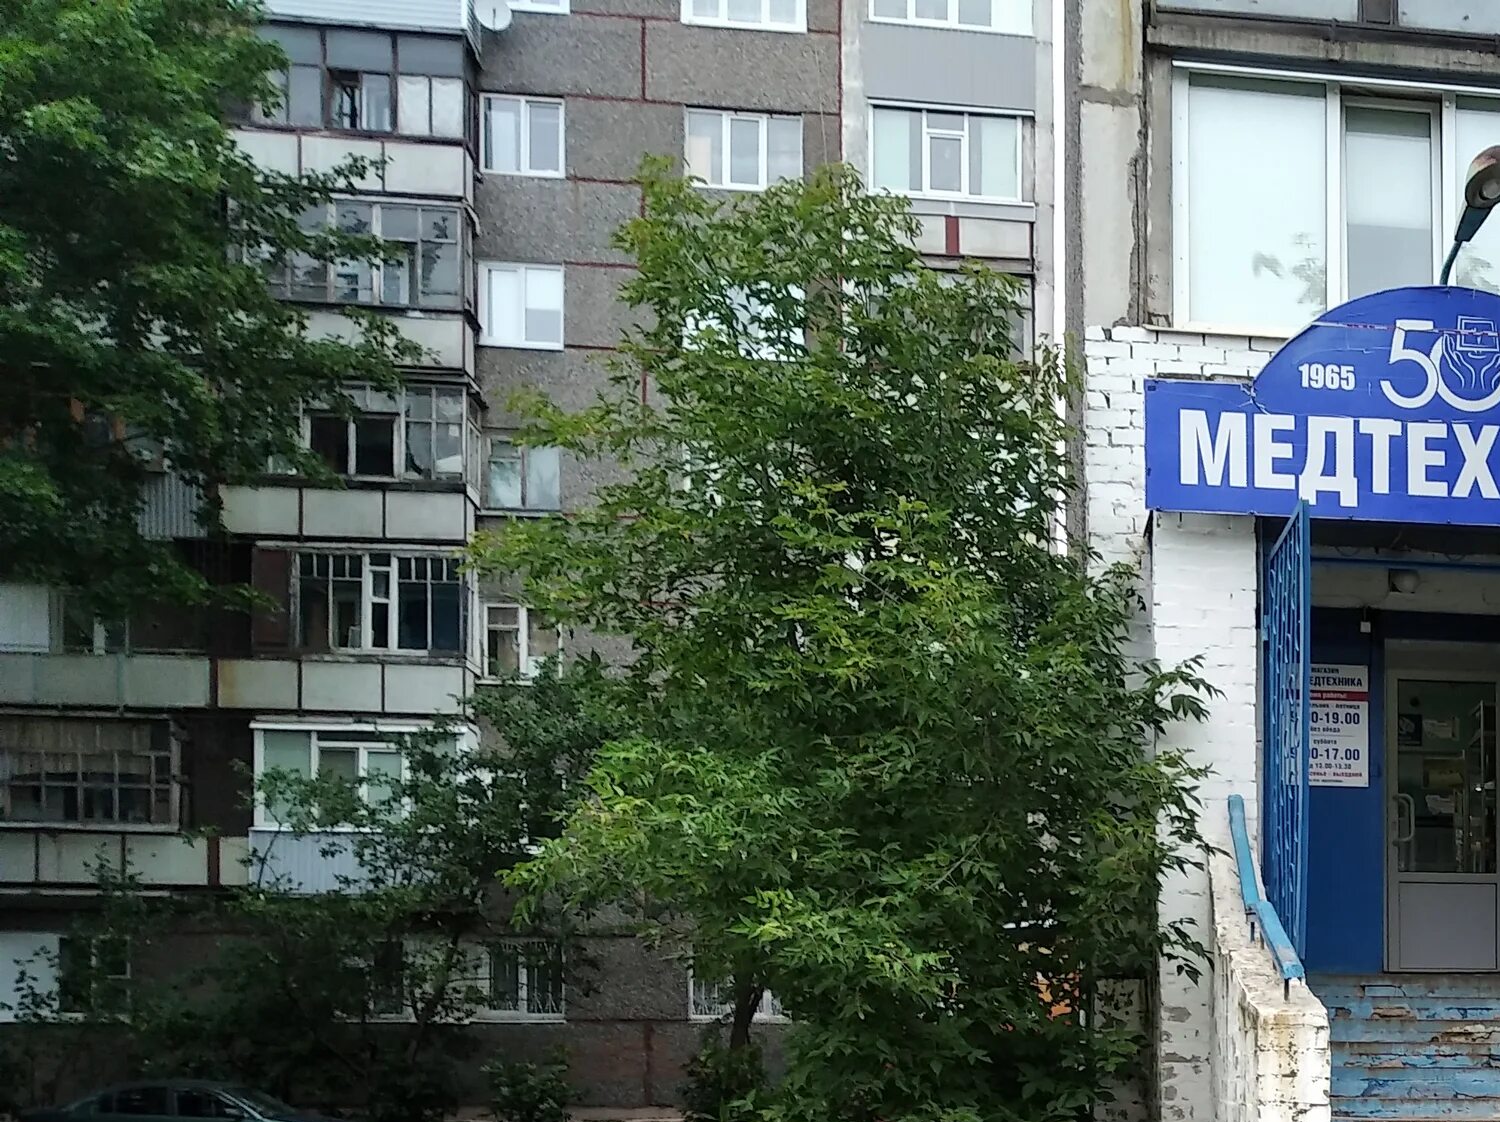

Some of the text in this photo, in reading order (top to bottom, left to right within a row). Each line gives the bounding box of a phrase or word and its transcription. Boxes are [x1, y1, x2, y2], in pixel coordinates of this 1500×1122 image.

[1298, 363, 1356, 391] 1965
[1310, 676, 1362, 687] ЕДТЕХНИКА
[1311, 711, 1360, 725] 0-19.00
[1311, 747, 1360, 761] 0-17.00
